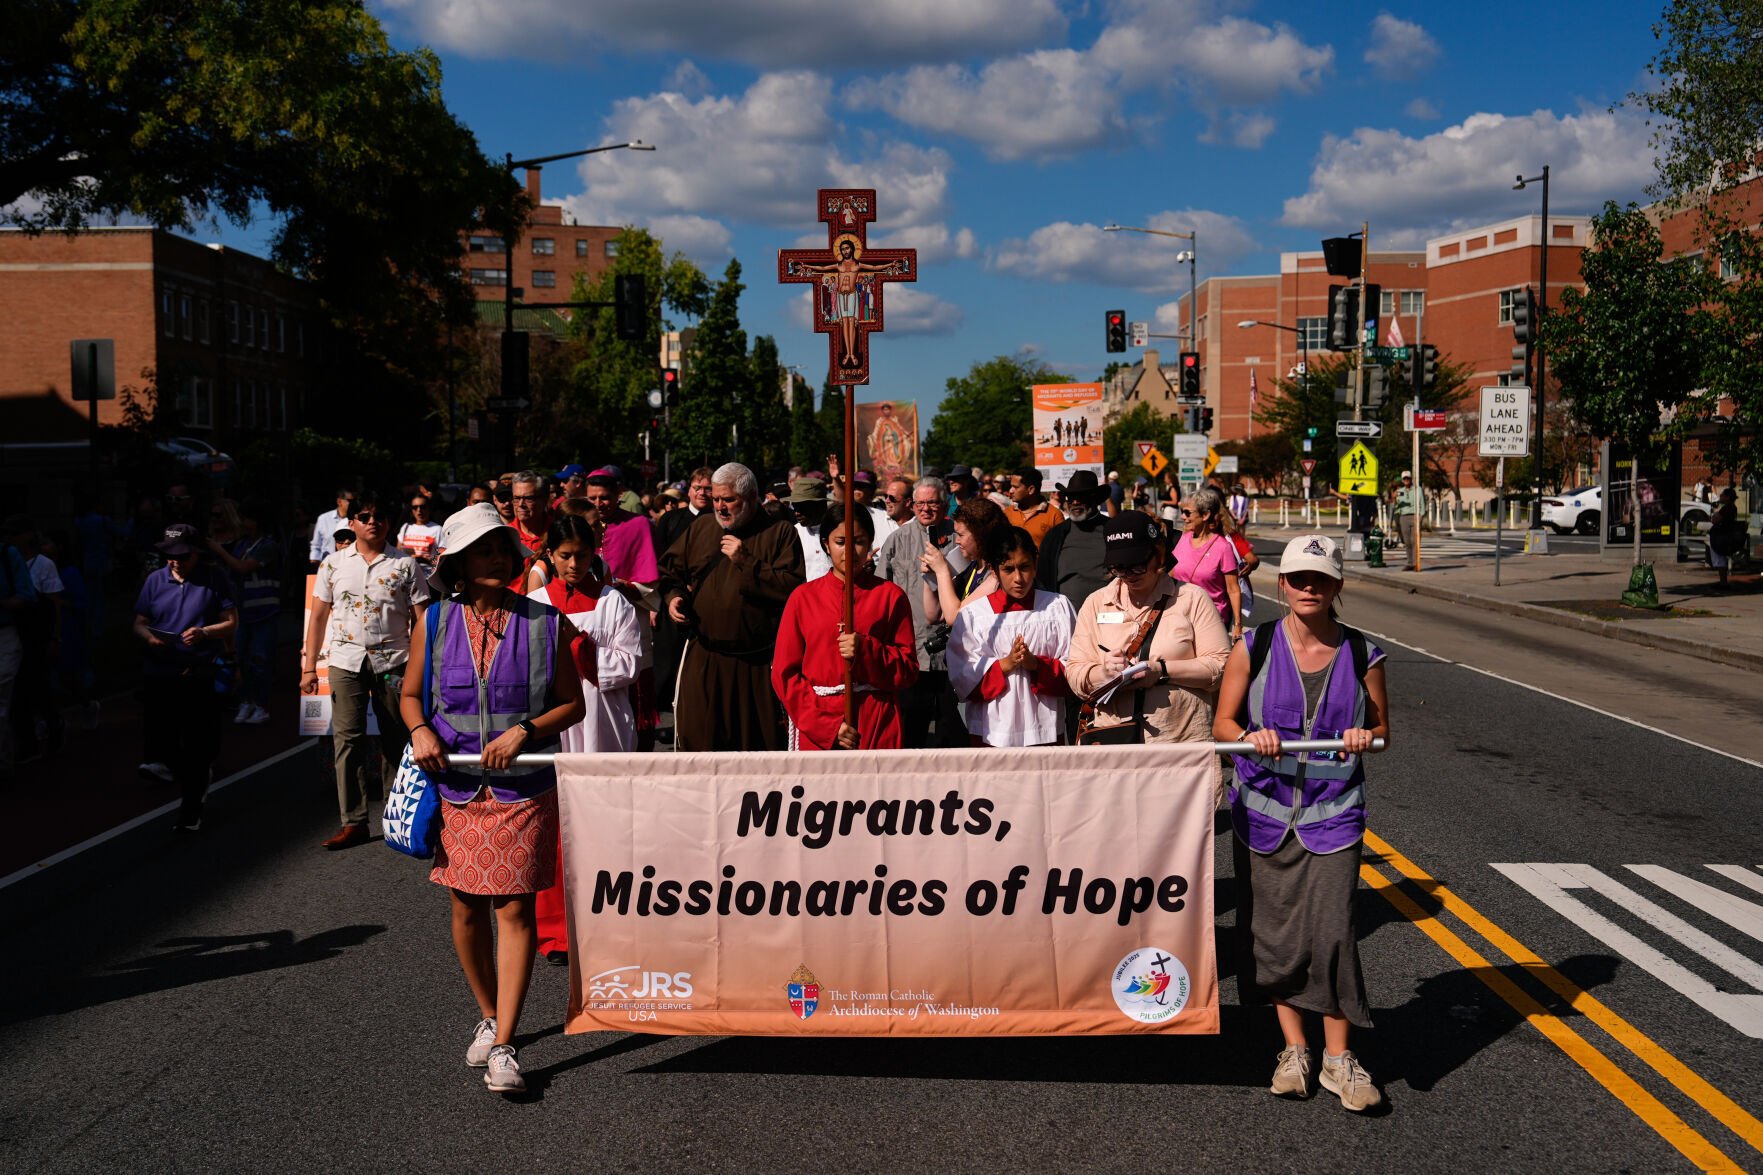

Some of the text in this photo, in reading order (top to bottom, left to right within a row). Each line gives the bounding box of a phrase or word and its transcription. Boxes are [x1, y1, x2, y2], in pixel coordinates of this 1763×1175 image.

[1494, 394, 1516, 404] BUS
[1490, 408, 1519, 418] LANE
[1486, 424, 1523, 434] AHEAD
[1106, 532, 1133, 542] MIAMI
[737, 786, 1012, 850] Migrants,
[591, 864, 1189, 927] Missionaries of Hope
[1116, 960, 1129, 980] JUBILEE
[632, 972, 693, 998] JRS
[828, 989, 935, 1000] The Roman Catholic
[1140, 976, 1187, 1020] PILGRIMS OF HOPE
[628, 1010, 657, 1022] USA
[829, 1002, 1000, 1020] Archdiocese of Washington
